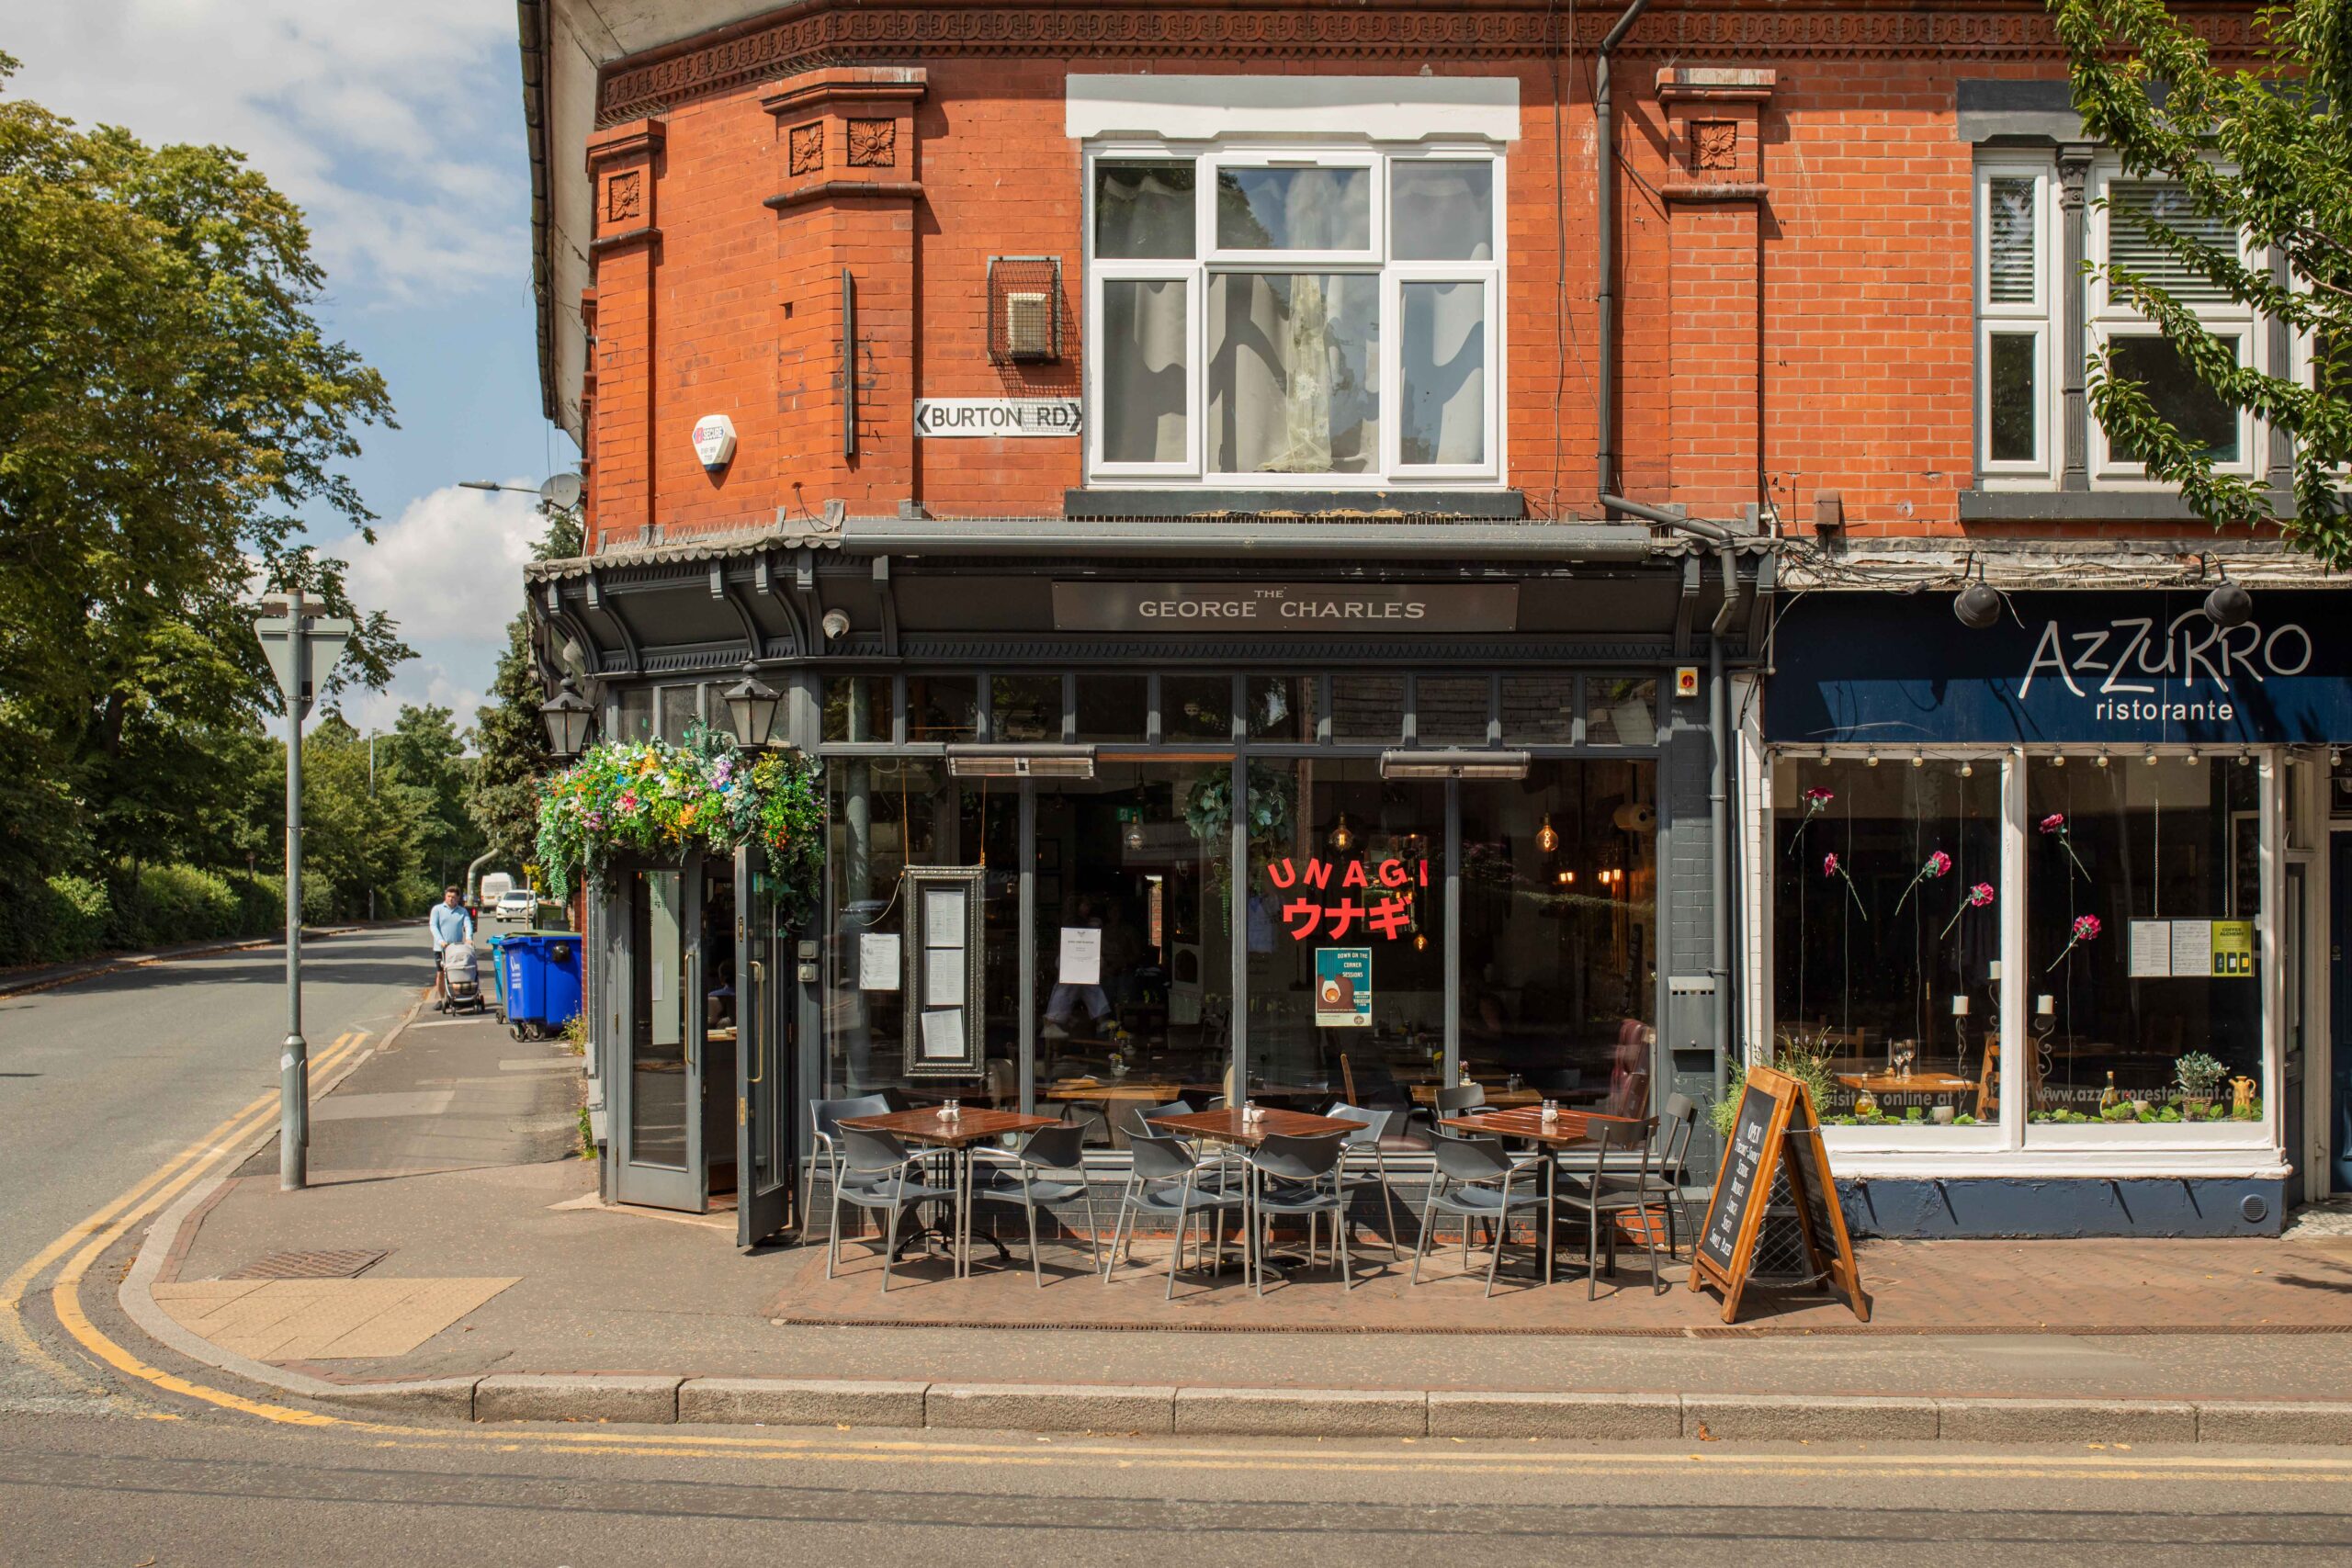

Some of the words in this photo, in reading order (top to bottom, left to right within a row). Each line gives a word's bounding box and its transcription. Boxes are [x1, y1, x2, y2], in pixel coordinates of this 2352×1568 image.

[932, 407, 1022, 427] BURTON
[1036, 406, 1070, 427] RD.
[1254, 590, 1284, 598] THE
[1138, 601, 1257, 618] GEORGE
[1280, 602, 1426, 619] CHARLES
[2095, 698, 2233, 720] ristorante
[1267, 857, 1428, 890] UNAGI
[1283, 896, 1412, 941] ウナギ
[1883, 1089, 1932, 1106] online
[1937, 1092, 1952, 1106] at
